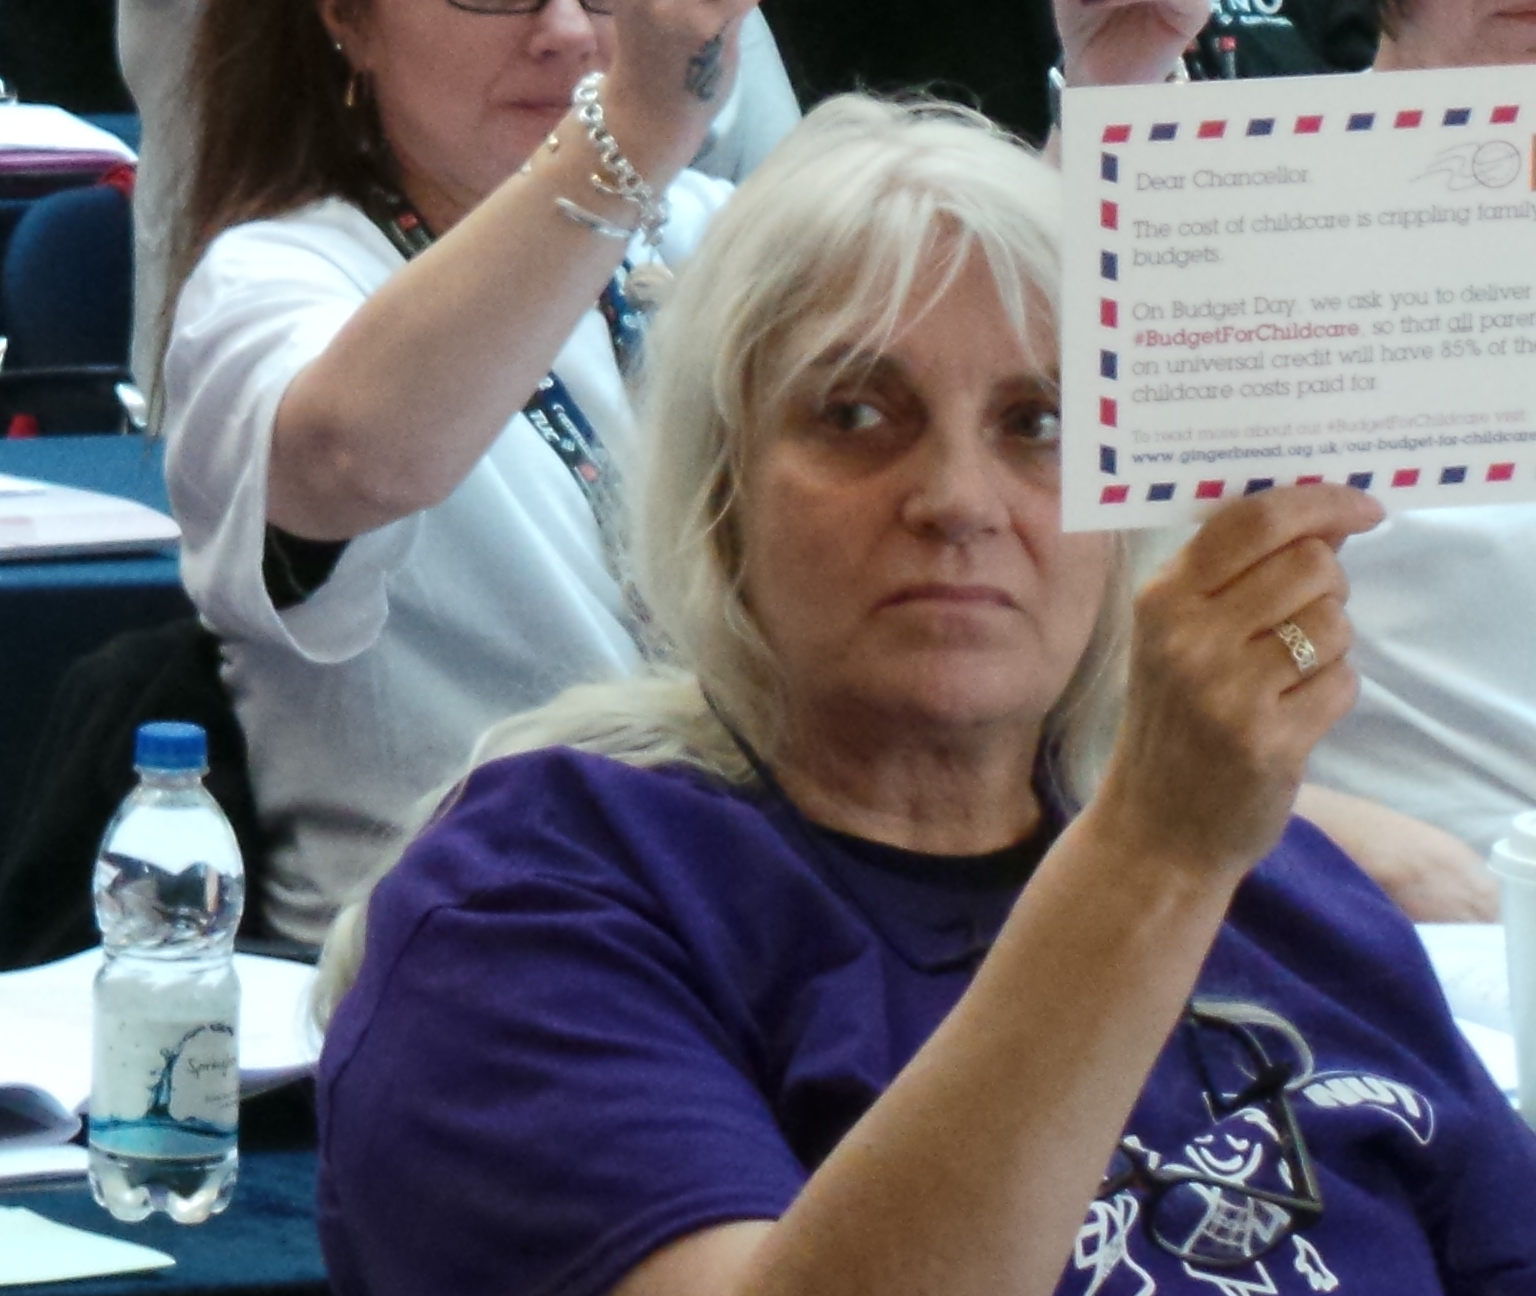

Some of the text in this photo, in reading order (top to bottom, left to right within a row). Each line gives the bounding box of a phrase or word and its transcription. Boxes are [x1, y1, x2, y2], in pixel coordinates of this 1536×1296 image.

[1136, 172, 1185, 191] Dear
[1132, 219, 1172, 238] The
[1177, 217, 1218, 236] cost
[1224, 215, 1245, 234] of
[1249, 213, 1351, 232] childcare
[1356, 212, 1373, 228] is
[1376, 206, 1474, 229] crippling
[1132, 301, 1165, 321] On
[1172, 298, 1246, 320] Budget
[1309, 296, 1342, 311] we
[1346, 290, 1384, 309] ask
[1388, 291, 1431, 311] you
[1435, 288, 1458, 305] to
[1461, 284, 1534, 303] deliver
[1371, 320, 1395, 335] so
[1399, 316, 1443, 333] that
[1448, 313, 1476, 333] all
[1132, 360, 1160, 376] on
[1166, 352, 1264, 374] universal
[1269, 349, 1330, 368] credit
[1336, 345, 1374, 364] will
[1379, 345, 1436, 362] have
[1440, 340, 1485, 359] 85%
[1488, 339, 1510, 356] of
[1131, 384, 1234, 403] childcare
[1238, 379, 1290, 398] costs
[1294, 374, 1343, 398] paid
[1302, 1076, 1421, 1118] NUT
